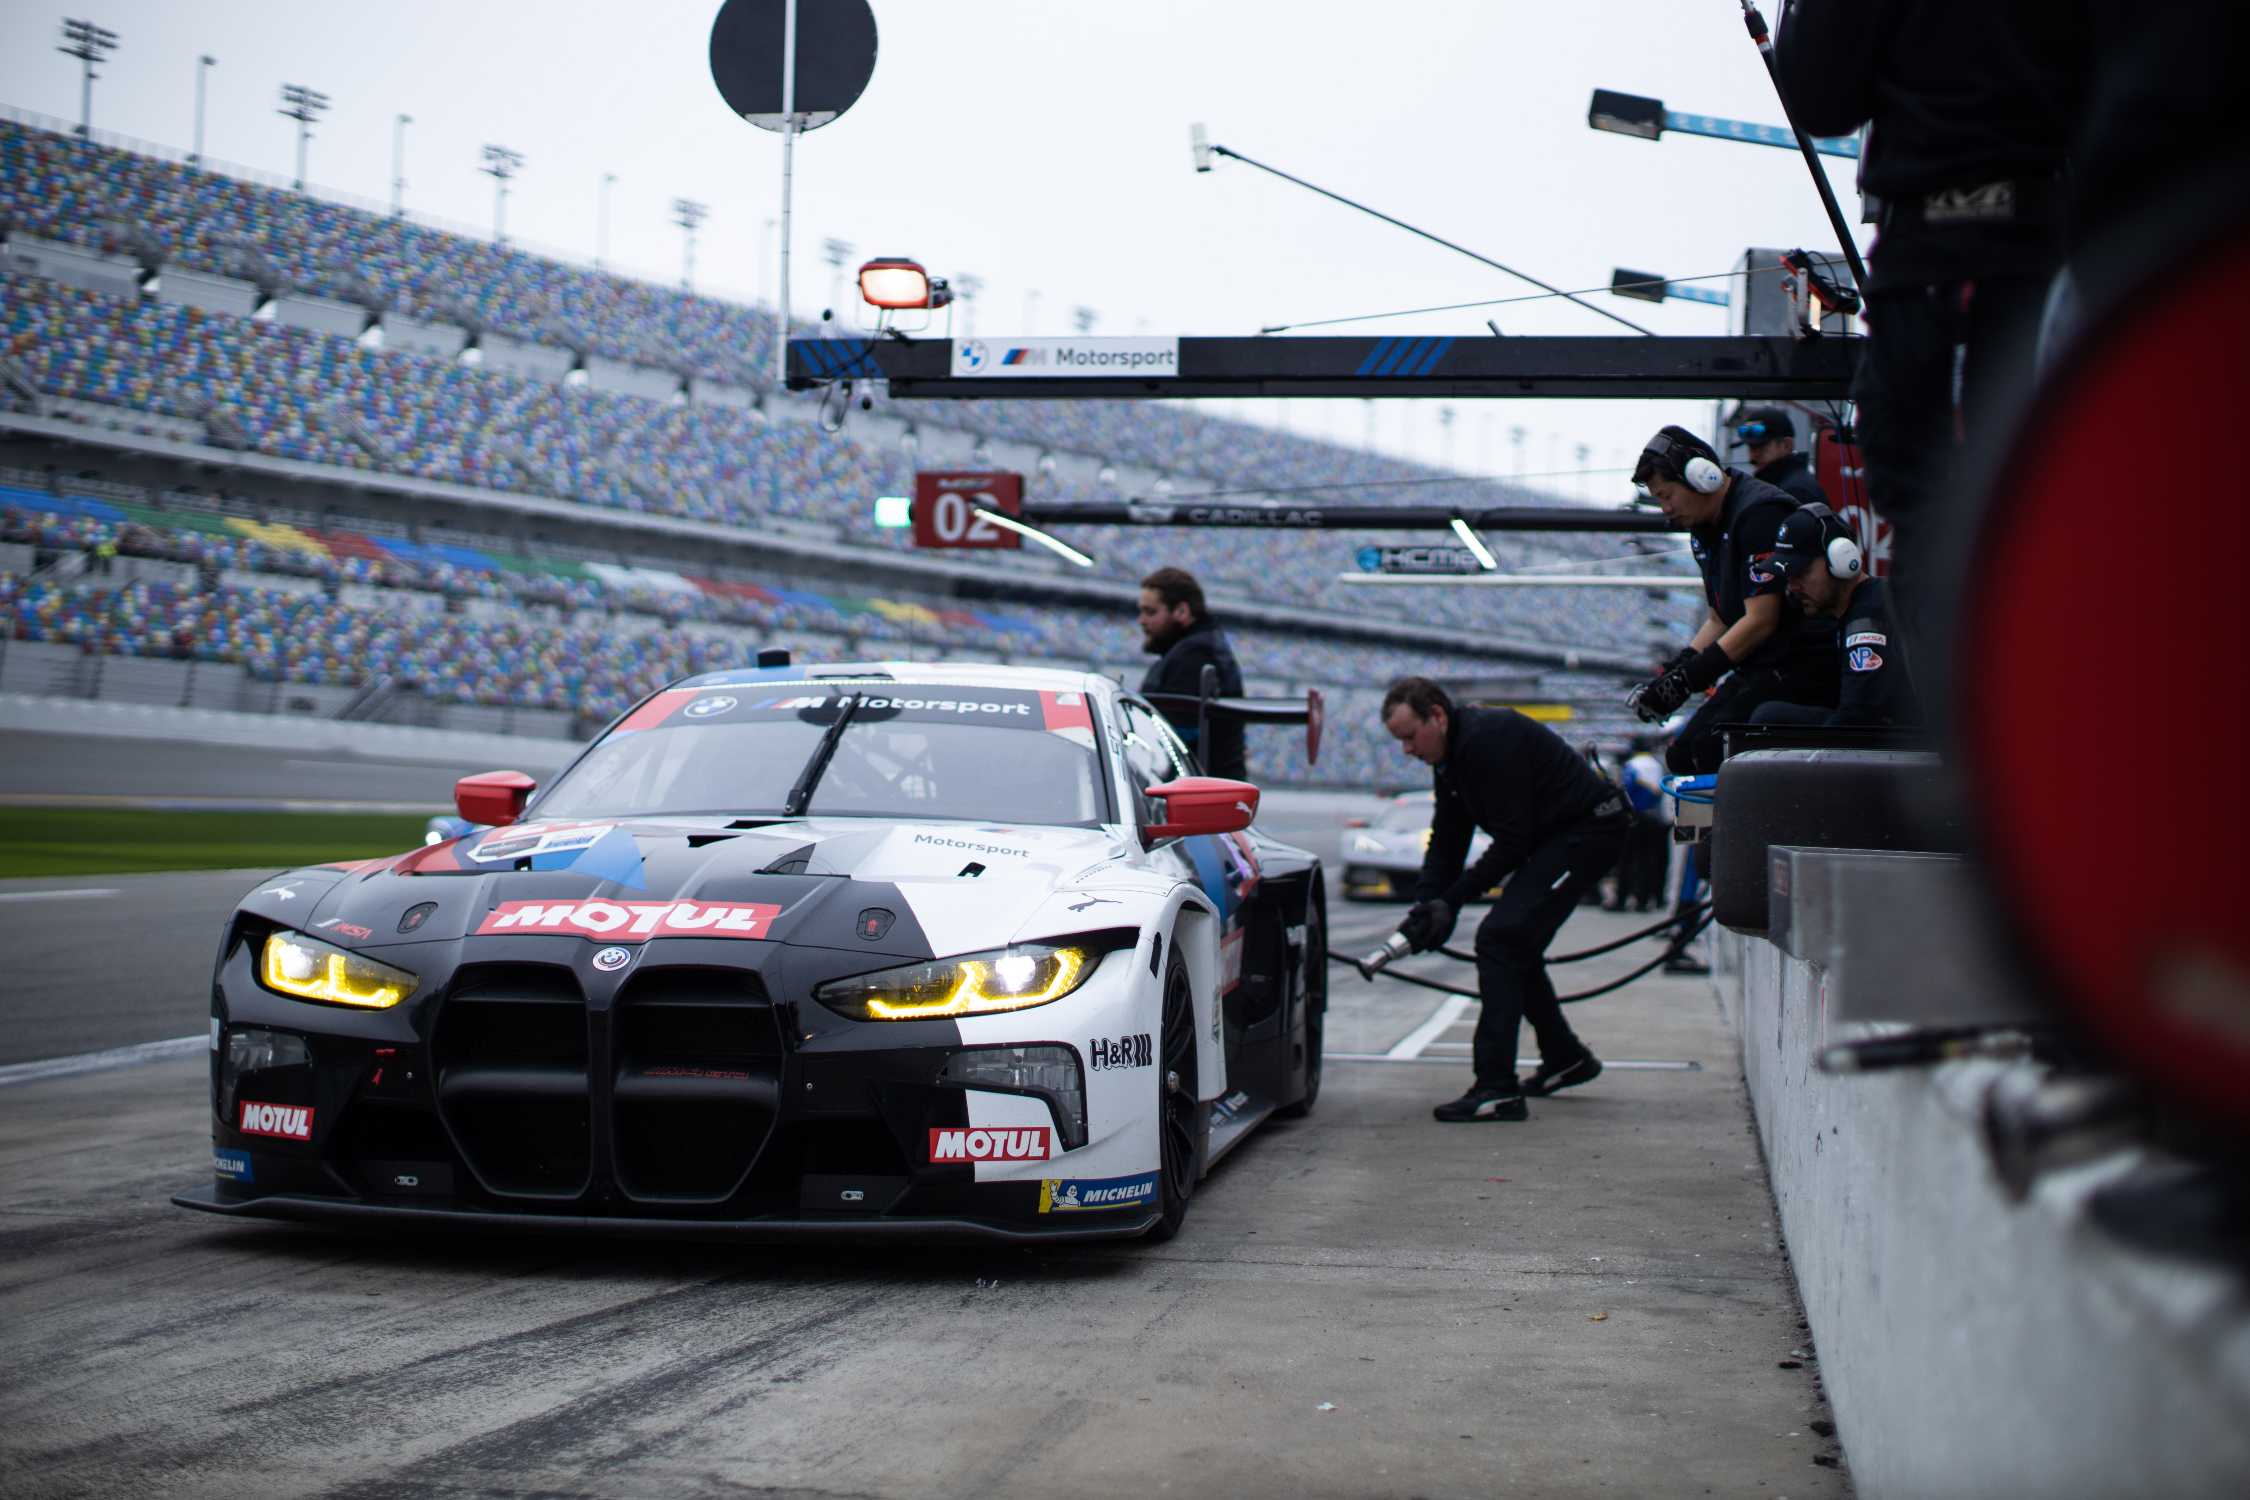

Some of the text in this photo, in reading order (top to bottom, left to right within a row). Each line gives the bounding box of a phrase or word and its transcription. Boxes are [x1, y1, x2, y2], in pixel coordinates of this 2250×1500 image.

[1056, 347, 1174, 368] Motorsport
[934, 493, 1000, 541] 02
[1189, 508, 1323, 526] CADILLAC
[837, 694, 1031, 715] Motorsport
[914, 833, 1031, 858] Motorsport
[491, 902, 759, 932] MOTUL
[241, 1103, 309, 1137] MOTUL
[934, 1129, 1045, 1159] MOTUL
[1083, 1181, 1153, 1203] MICHELIN
